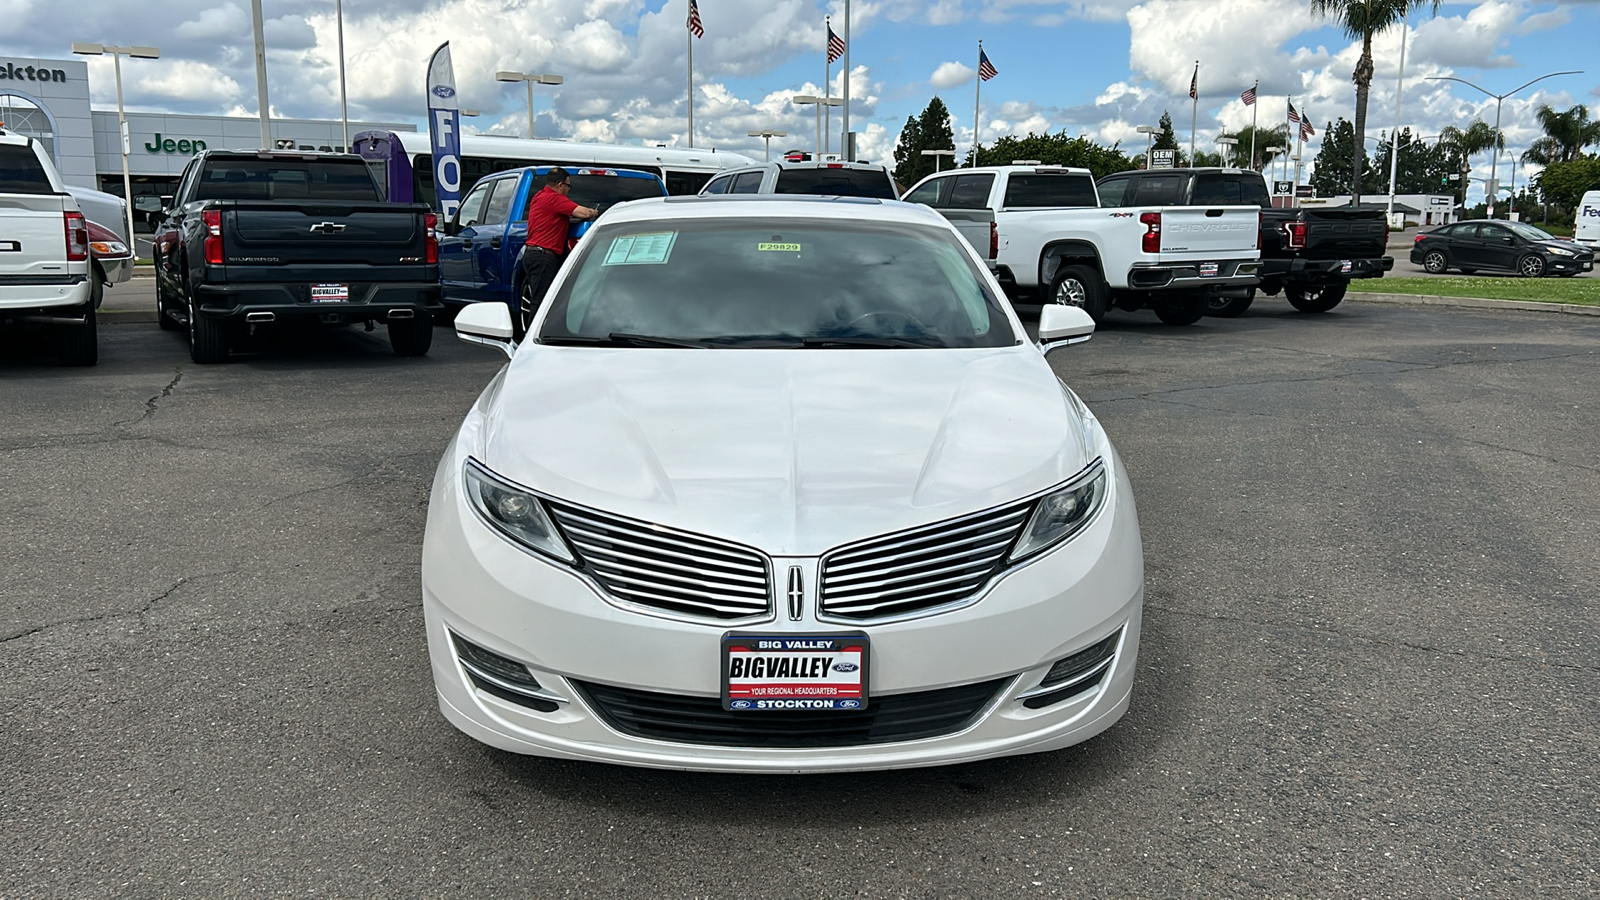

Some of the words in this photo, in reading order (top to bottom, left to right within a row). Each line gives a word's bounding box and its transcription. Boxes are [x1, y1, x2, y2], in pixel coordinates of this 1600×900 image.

[145, 132, 207, 156] Jeep
[1169, 222, 1254, 233] CHEVROLET
[1310, 224, 1384, 234] FORD
[758, 640, 782, 649] BIG
[786, 640, 833, 649] VALLEY
[729, 657, 834, 678] BIGVALLEY
[795, 687, 838, 695] HEADQUARTERS
[757, 700, 834, 708] STOCKTON
